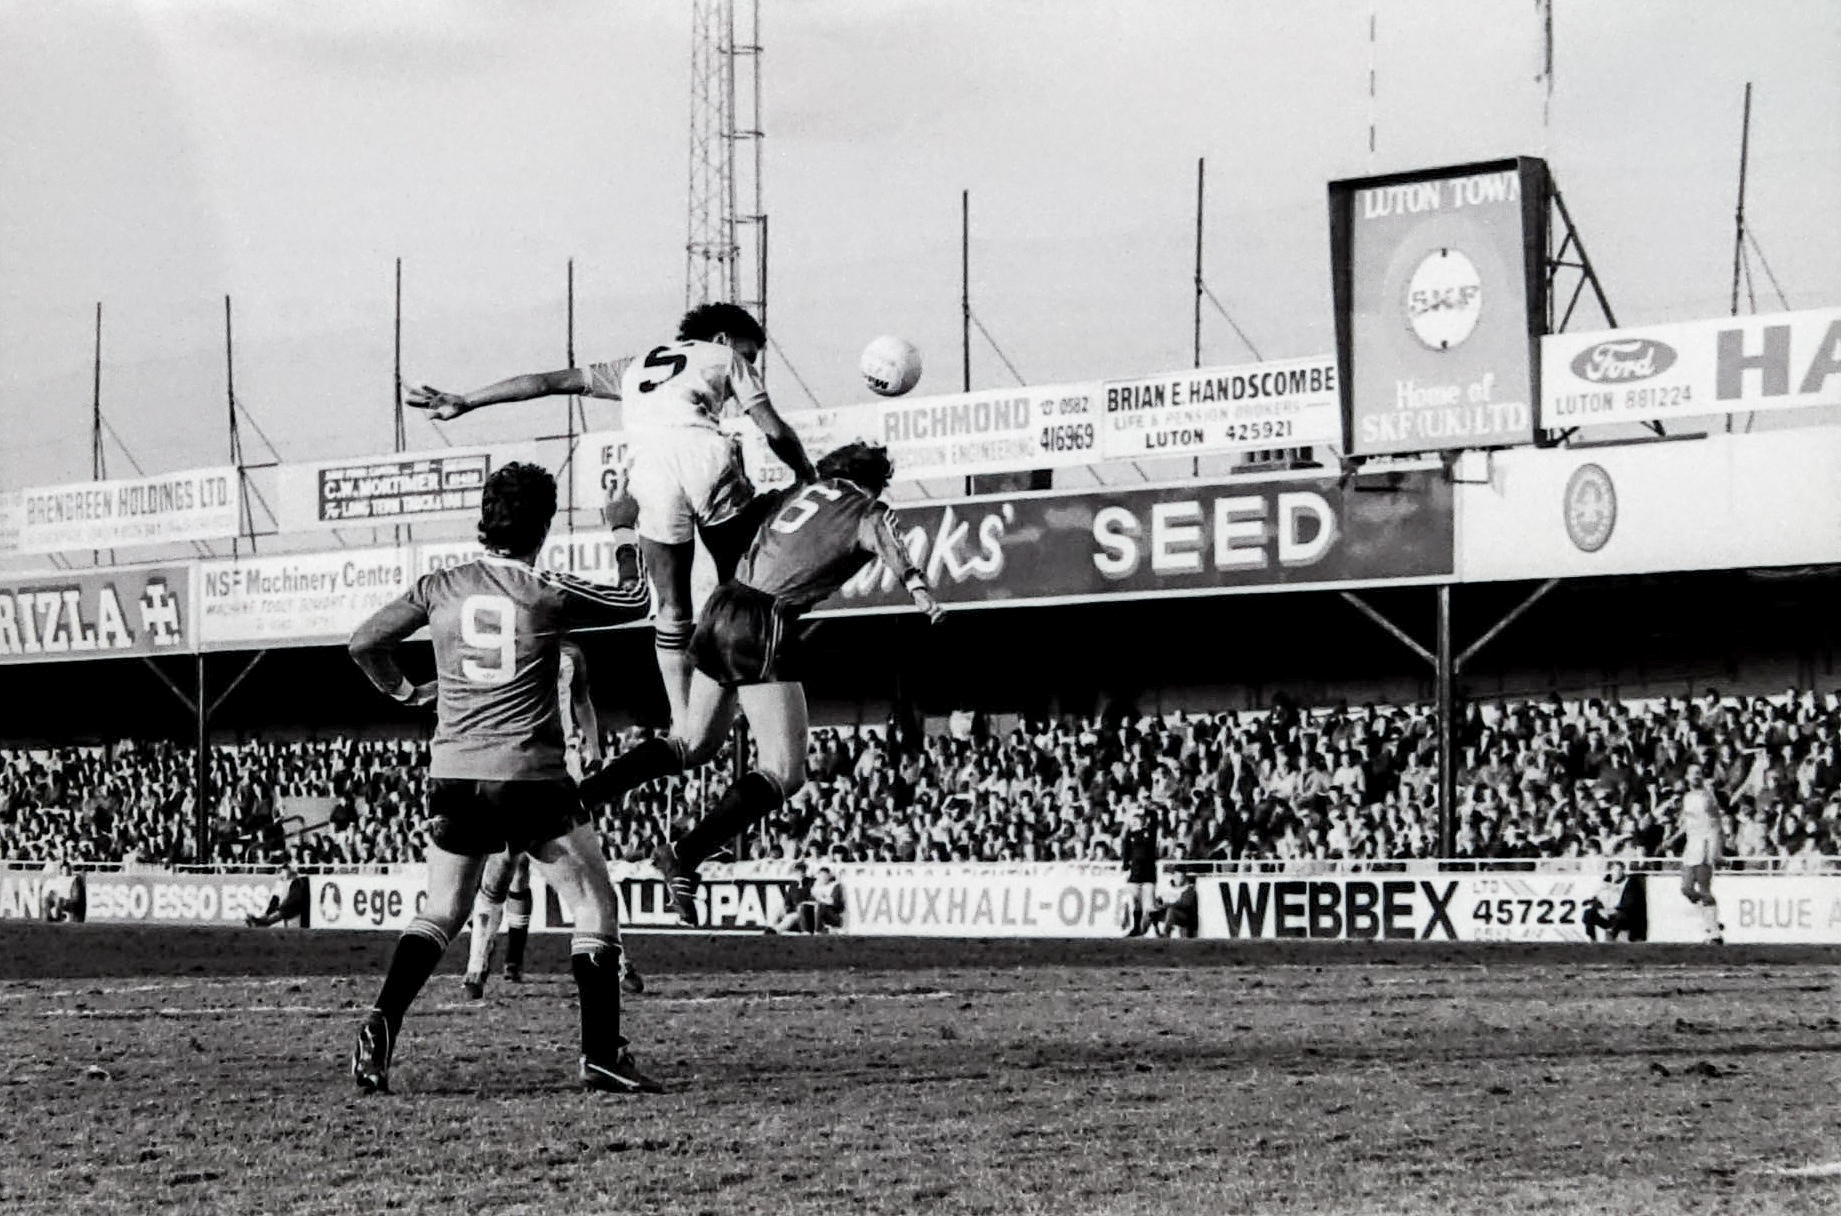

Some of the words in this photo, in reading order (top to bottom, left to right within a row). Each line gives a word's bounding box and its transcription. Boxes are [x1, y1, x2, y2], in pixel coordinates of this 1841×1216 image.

[1364, 182, 1441, 220] LUTON
[638, 345, 688, 394] 5
[1585, 340, 1656, 381] Ford
[1106, 383, 1165, 413] BRIAN
[1187, 365, 1334, 404] HANDSCOMBE
[1395, 379, 1461, 410] Home
[1466, 372, 1495, 404] of
[1556, 390, 1615, 416] LUTON
[885, 397, 1030, 443] RICHMOND
[1038, 422, 1094, 453] 416969
[1144, 429, 1204, 450] LUTON
[1224, 421, 1292, 442] 425921
[117, 481, 195, 518] HOLDINGS
[769, 484, 843, 535] 6
[1092, 490, 1337, 580] SEED
[244, 566, 339, 594] Machinery
[341, 561, 402, 590] Centre
[461, 593, 516, 683] 9
[86, 883, 149, 919] ESSO
[152, 883, 218, 919] ESSO
[220, 884, 272, 920] ESS
[354, 889, 403, 926] ege
[1218, 880, 1460, 940] WEBBEX
[1738, 897, 1812, 929] BLUE
